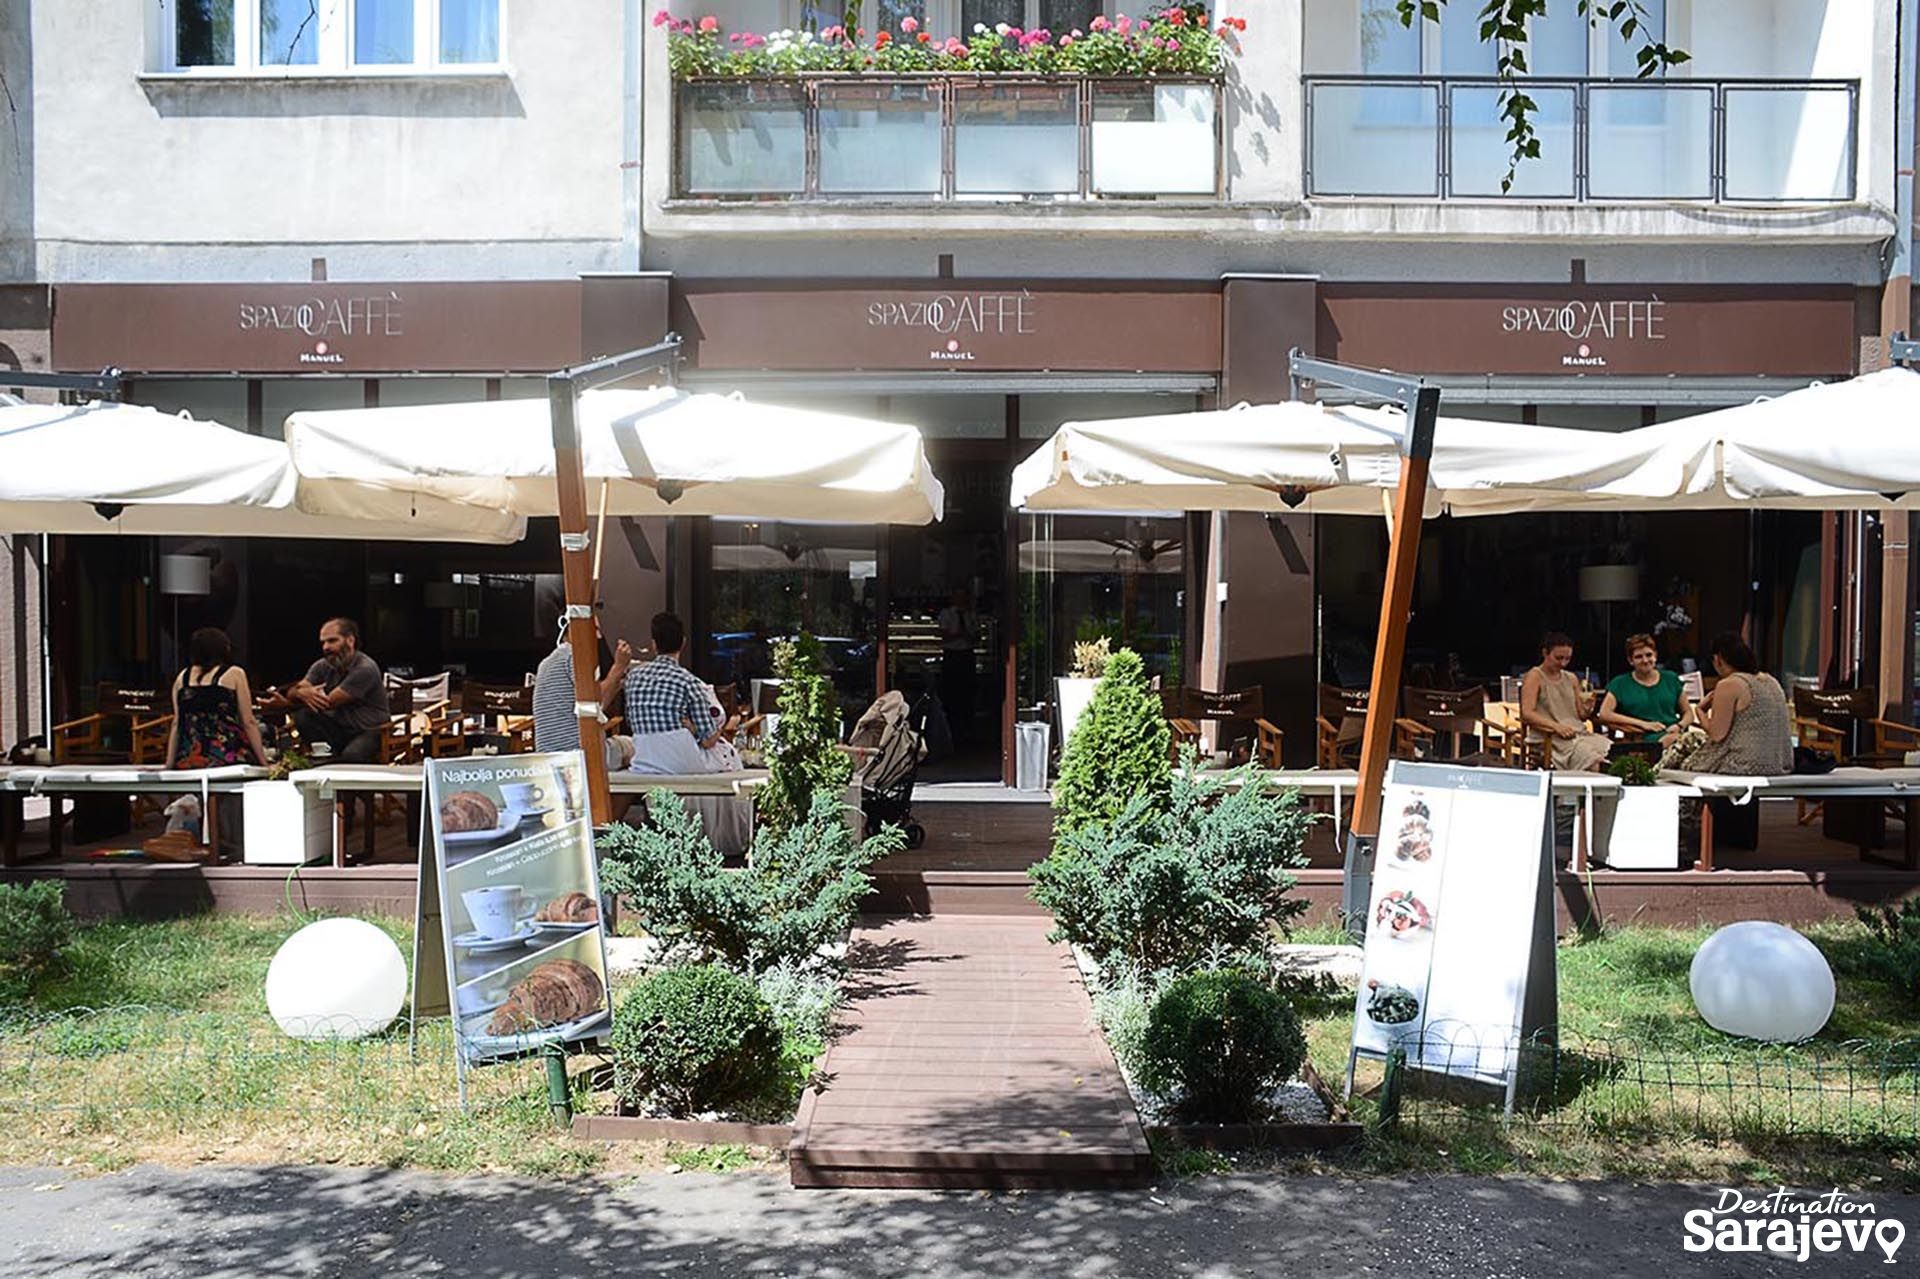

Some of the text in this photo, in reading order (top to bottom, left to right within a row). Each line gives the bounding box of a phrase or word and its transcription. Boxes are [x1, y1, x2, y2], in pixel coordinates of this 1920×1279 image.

[303, 291, 403, 336] CAFFÈ
[934, 287, 1036, 334] CAFFÈ
[1566, 293, 1666, 339] CAFFÈ
[300, 353, 344, 363] MANUEL
[930, 351, 976, 360] MANUEL
[1562, 356, 1606, 366] MANUEL
[442, 768, 493, 784] Najbolja
